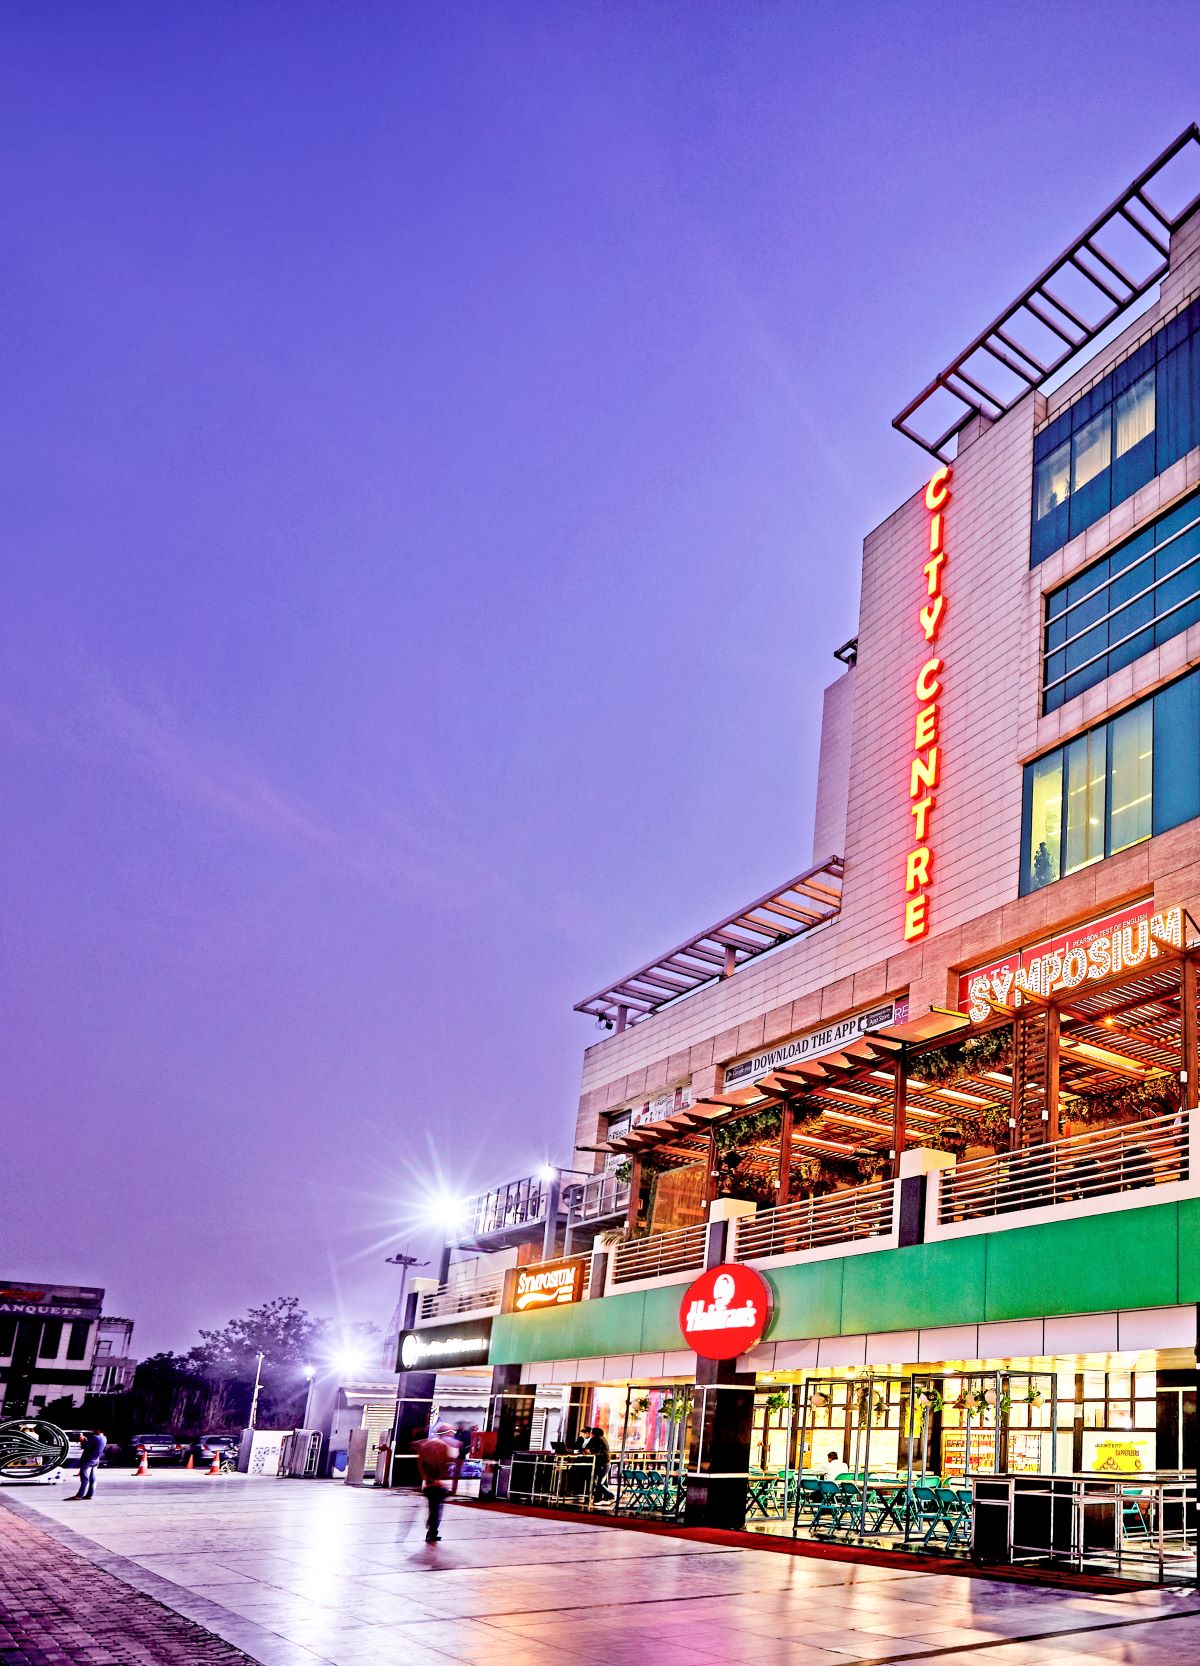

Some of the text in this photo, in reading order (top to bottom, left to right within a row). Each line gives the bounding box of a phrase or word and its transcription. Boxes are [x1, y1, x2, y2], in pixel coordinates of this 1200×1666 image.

[904, 467, 952, 943] CITY CENTRE
[1072, 913, 1148, 947] PEARSON TEST OF ENGLISH
[969, 907, 1183, 1023] SYMPOSIUM
[753, 1020, 857, 1072] DOWNLOAD THE APP
[517, 1267, 576, 1294] SYMPOSIUM
